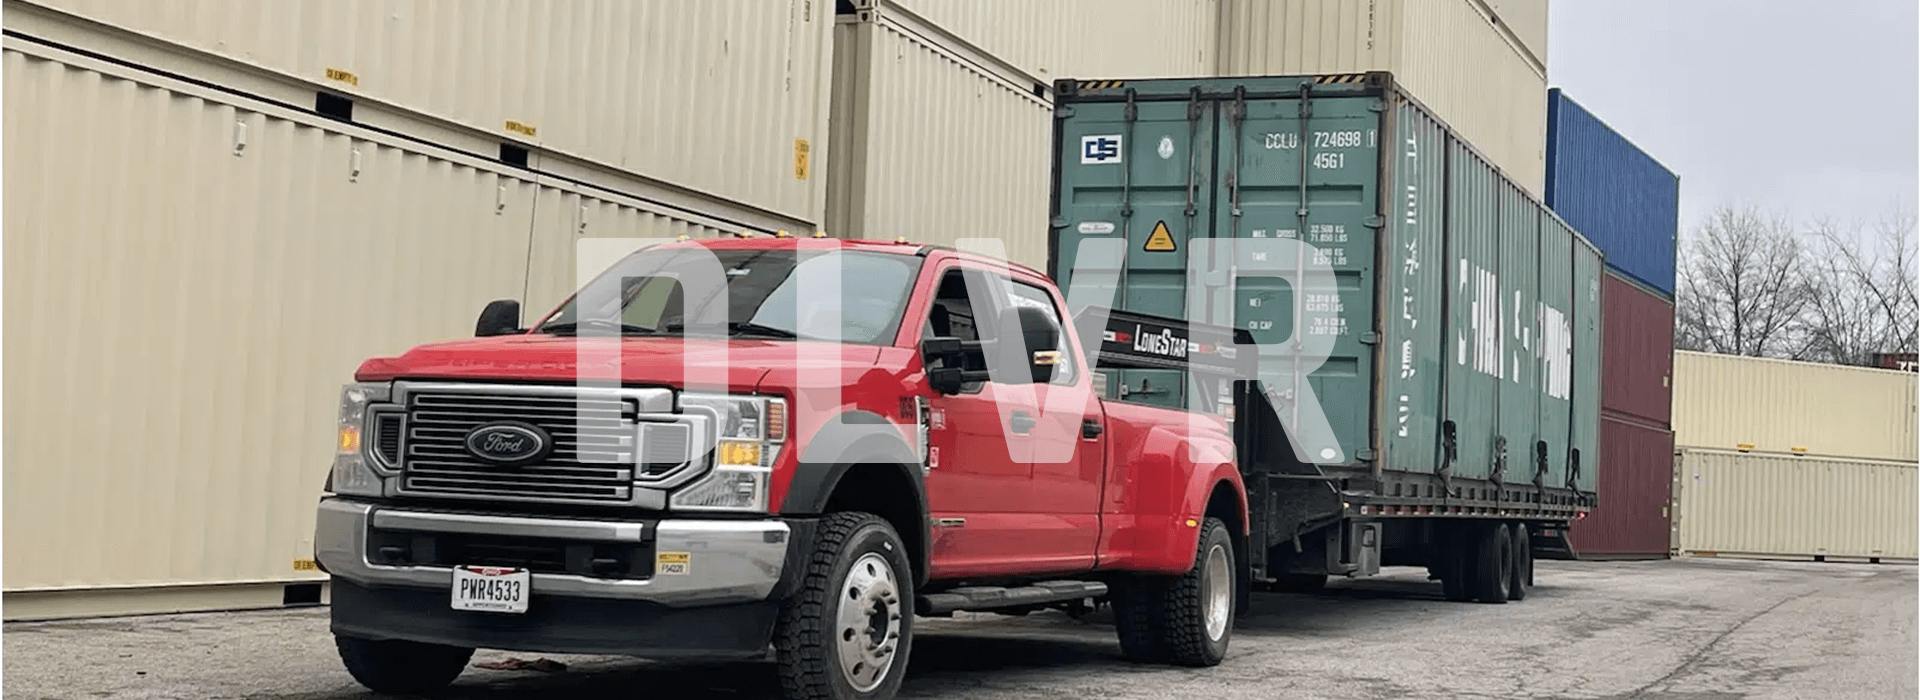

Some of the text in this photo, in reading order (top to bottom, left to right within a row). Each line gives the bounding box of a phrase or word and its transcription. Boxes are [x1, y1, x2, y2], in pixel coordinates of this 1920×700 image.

[1265, 133, 1297, 149] CCLU
[1313, 131, 1361, 148] 724698
[1312, 153, 1344, 169] 45G1
[1335, 224, 1345, 233] KG
[1334, 233, 1348, 242] LBS
[484, 432, 524, 452] Ford
